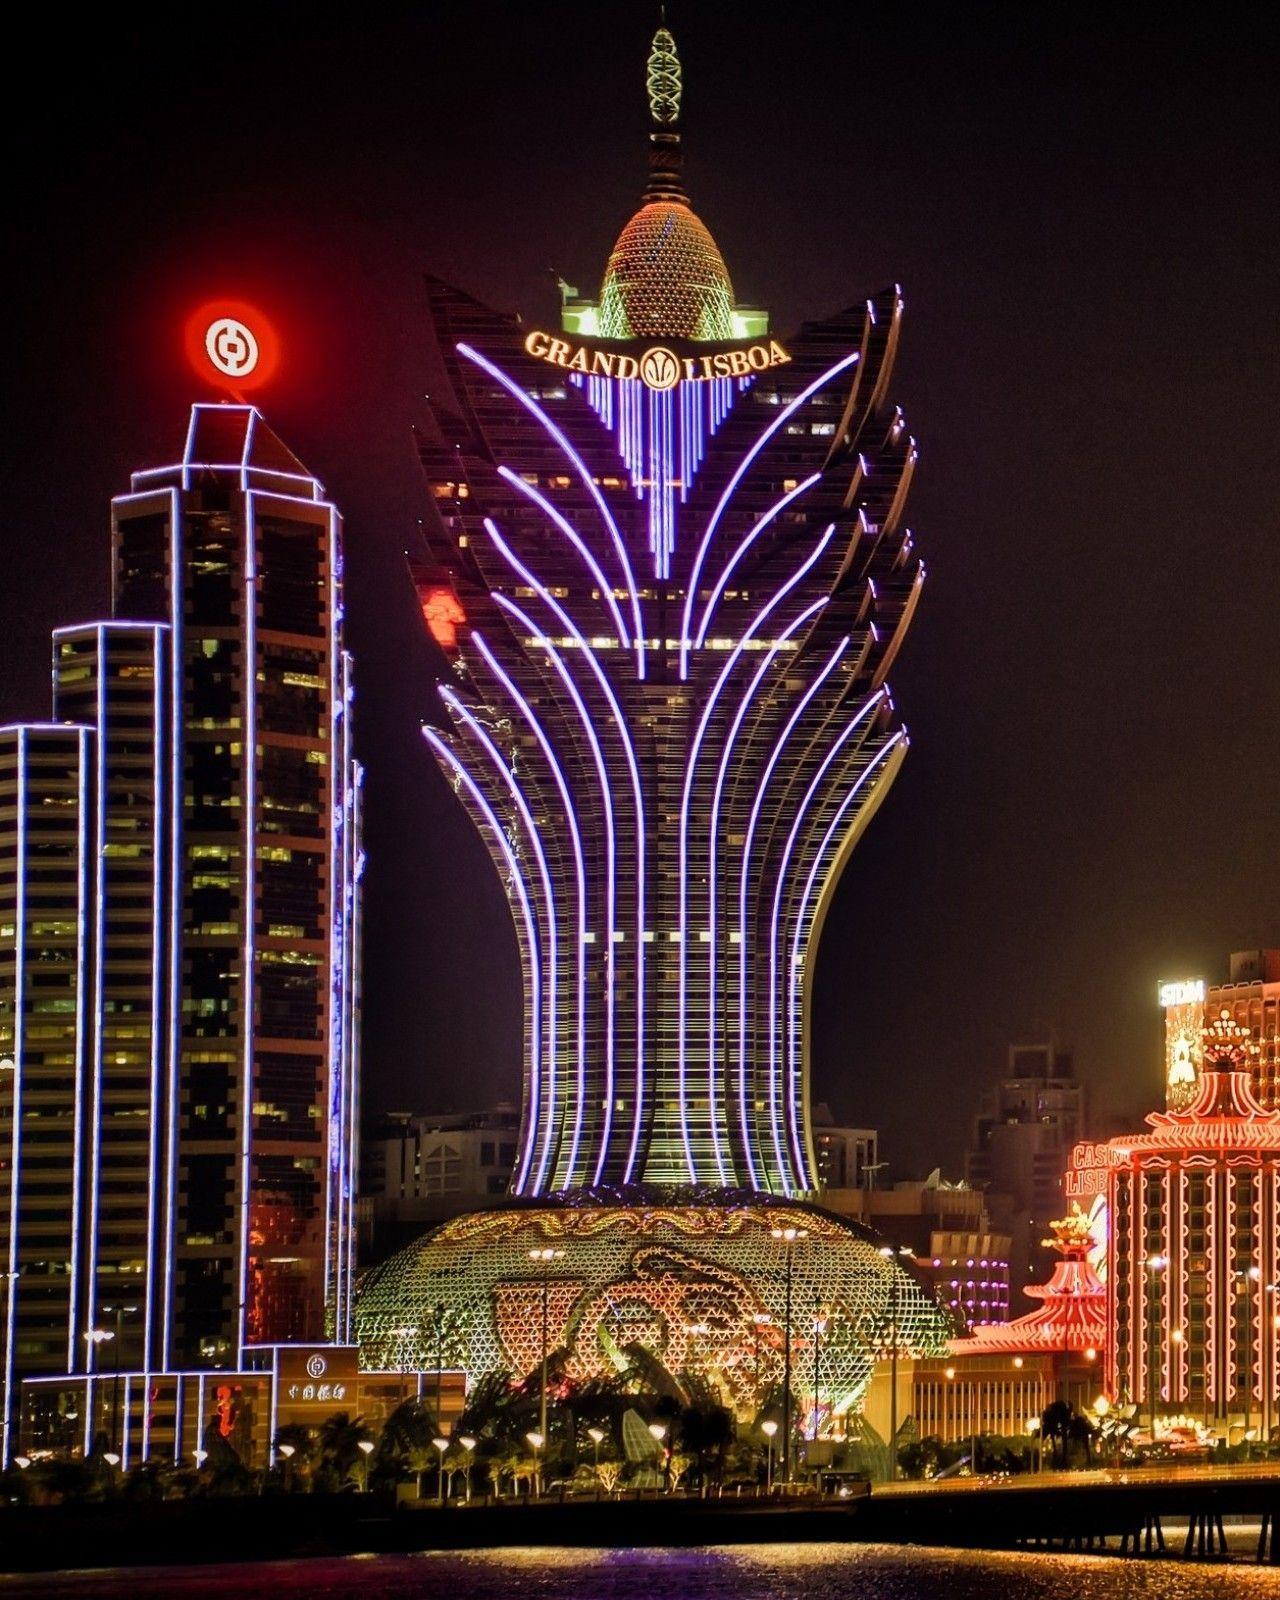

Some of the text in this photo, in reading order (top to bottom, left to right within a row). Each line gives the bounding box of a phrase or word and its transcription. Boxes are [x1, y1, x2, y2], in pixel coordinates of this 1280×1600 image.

[524, 331, 792, 381] GRAND LISBOA
[1066, 1169, 1108, 1196] LISB
